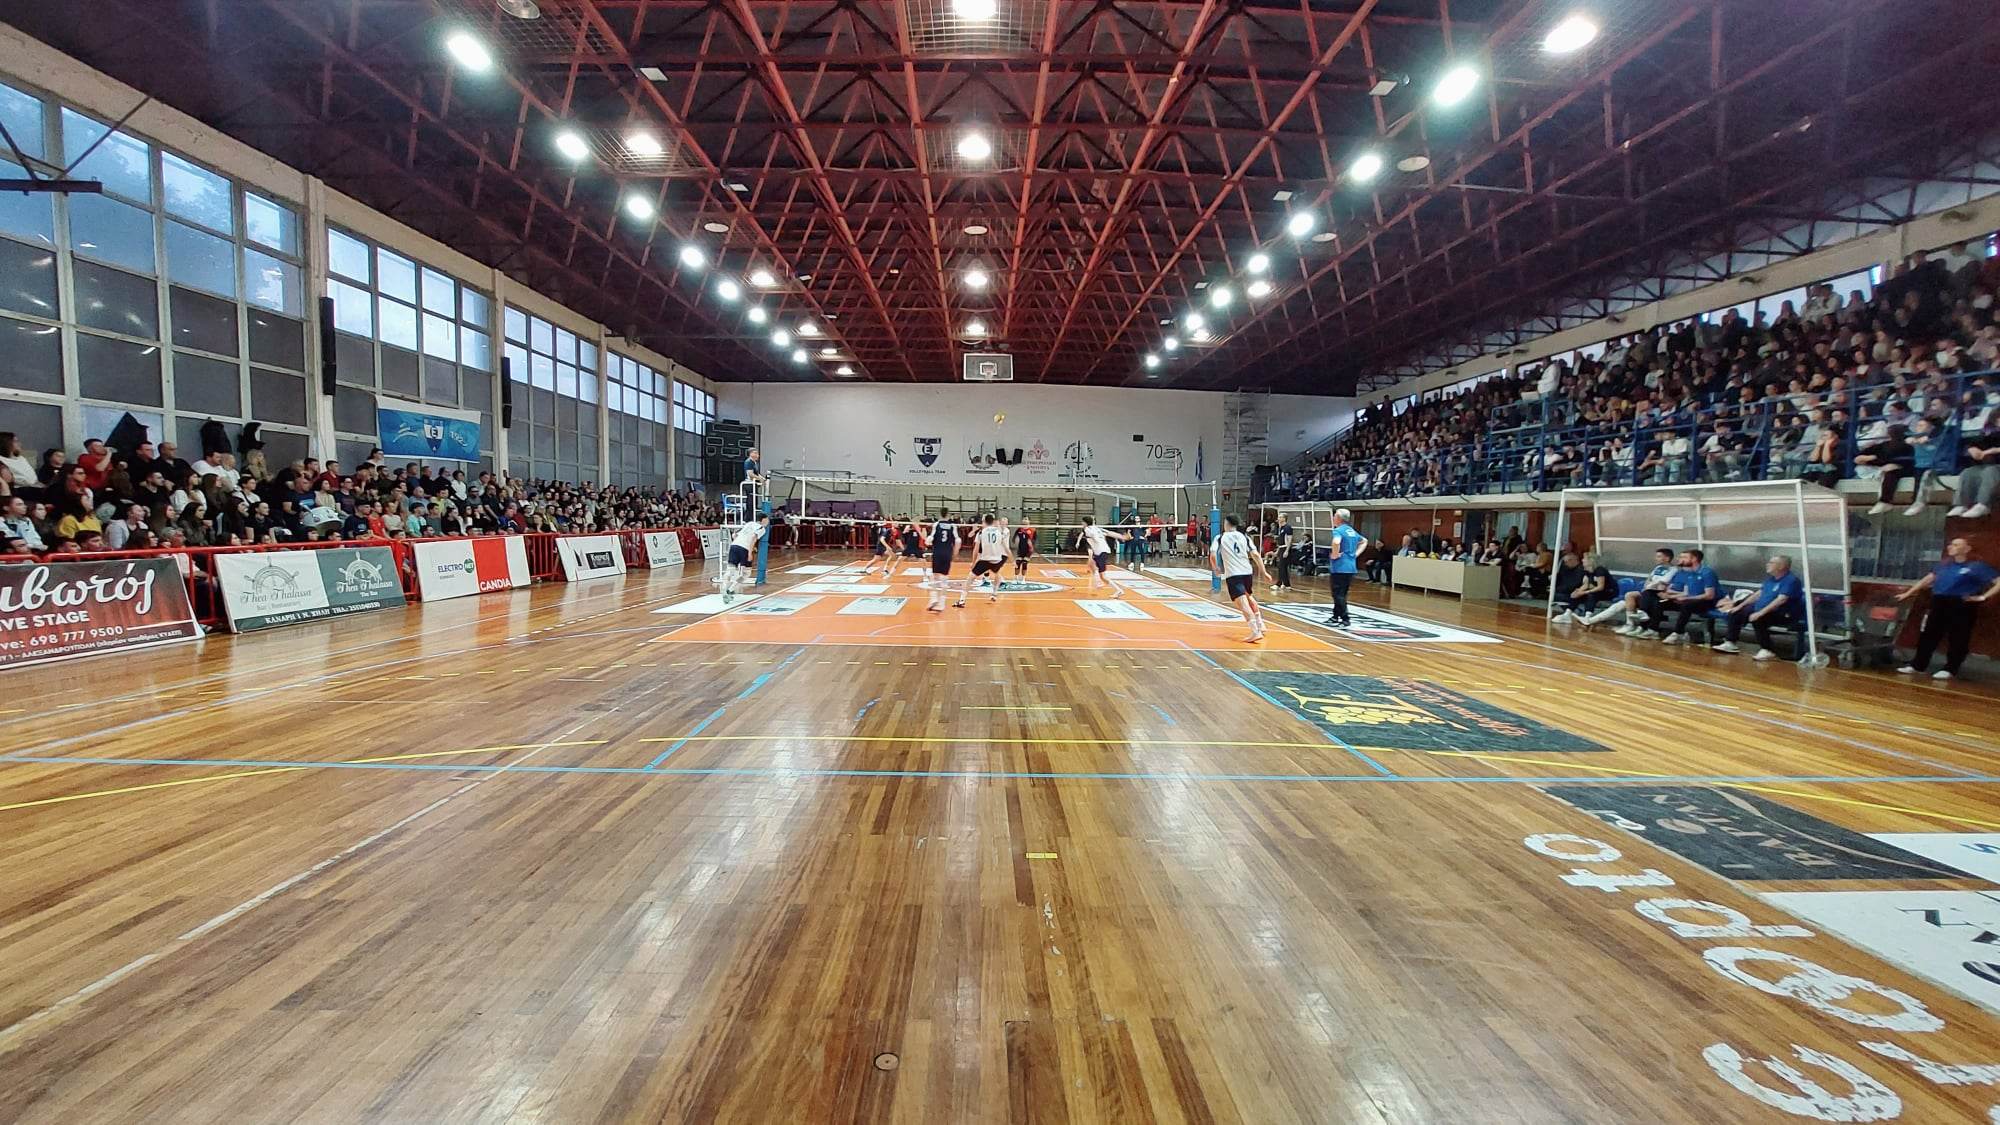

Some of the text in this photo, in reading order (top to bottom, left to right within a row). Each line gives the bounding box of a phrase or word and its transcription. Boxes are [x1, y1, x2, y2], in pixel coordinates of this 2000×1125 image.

[1145, 444, 1163, 459] 70
[941, 530, 947, 543] 3
[987, 532, 997, 544] 10
[438, 563, 463, 573] ELECTRO
[335, 579, 393, 594] Thea Thalassa
[480, 577, 512, 591] CANDIA
[240, 588, 312, 604] Thea Thalassa
[32, 610, 91, 628] STAGE
[30, 634, 58, 647] 698
[62, 630, 86, 642] 777
[90, 625, 123, 639] 9500
